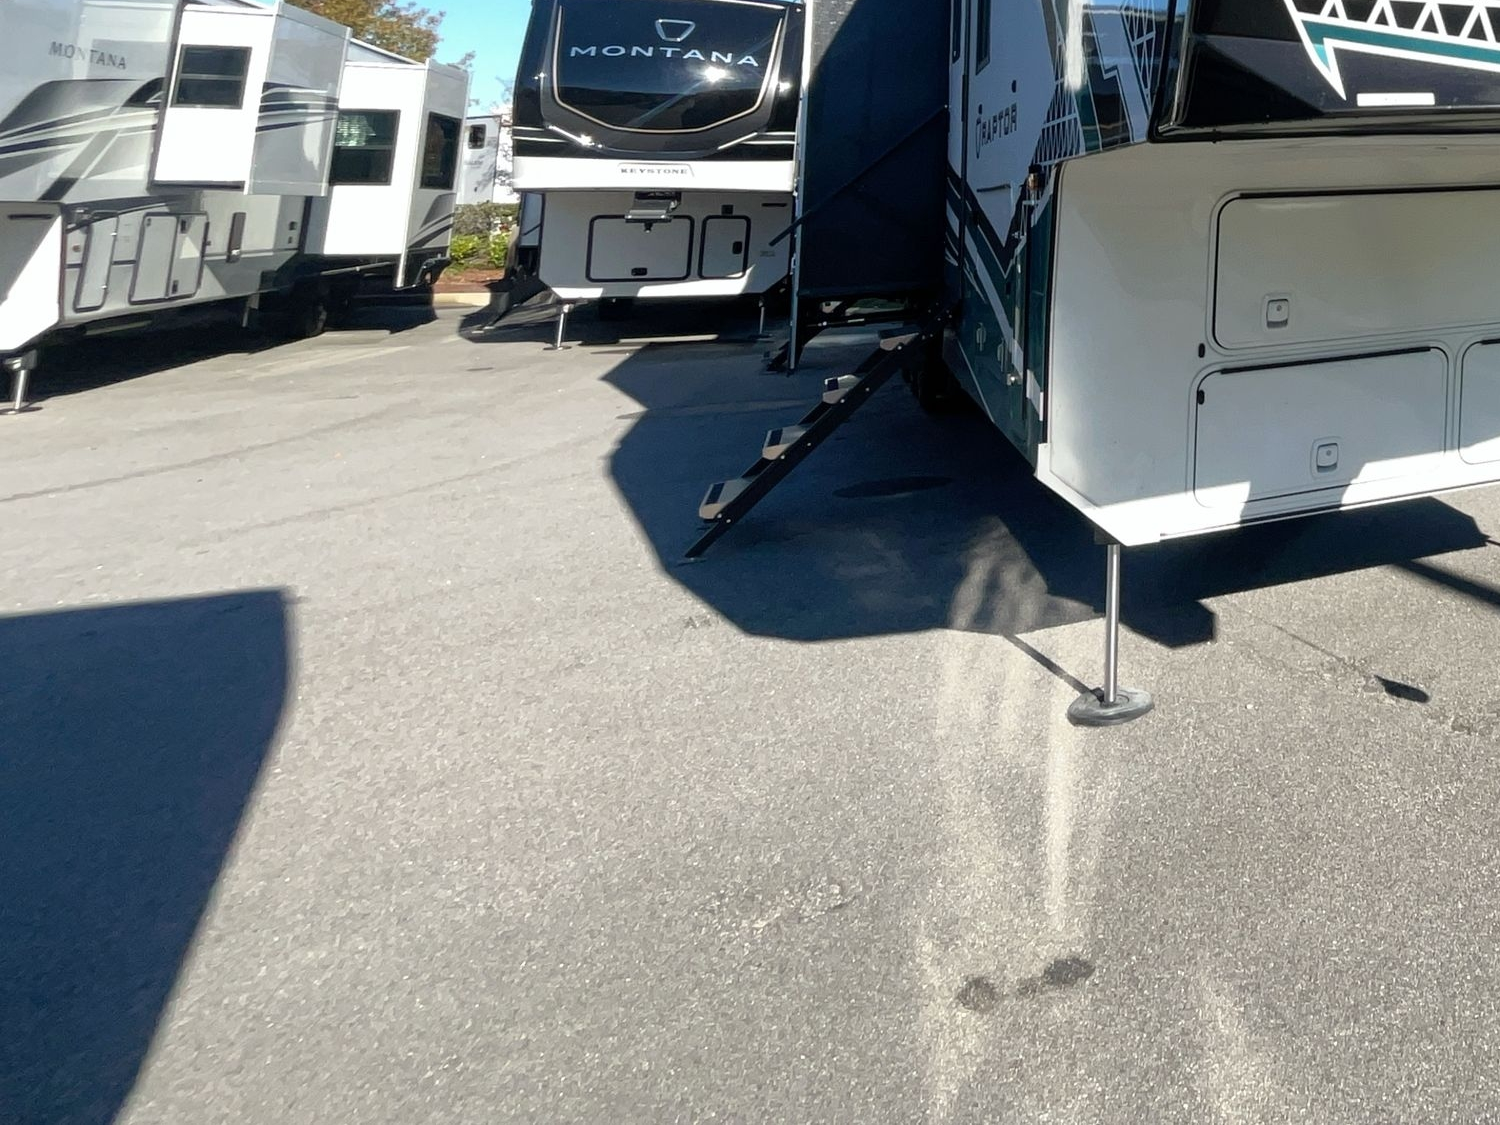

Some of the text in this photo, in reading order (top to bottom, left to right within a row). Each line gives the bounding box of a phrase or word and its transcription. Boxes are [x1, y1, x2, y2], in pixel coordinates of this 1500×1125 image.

[48, 41, 126, 70] MONTANA
[570, 46, 759, 67] MONTANA
[981, 102, 1017, 147] RAPTOR
[620, 167, 688, 176] KEYSTONE
